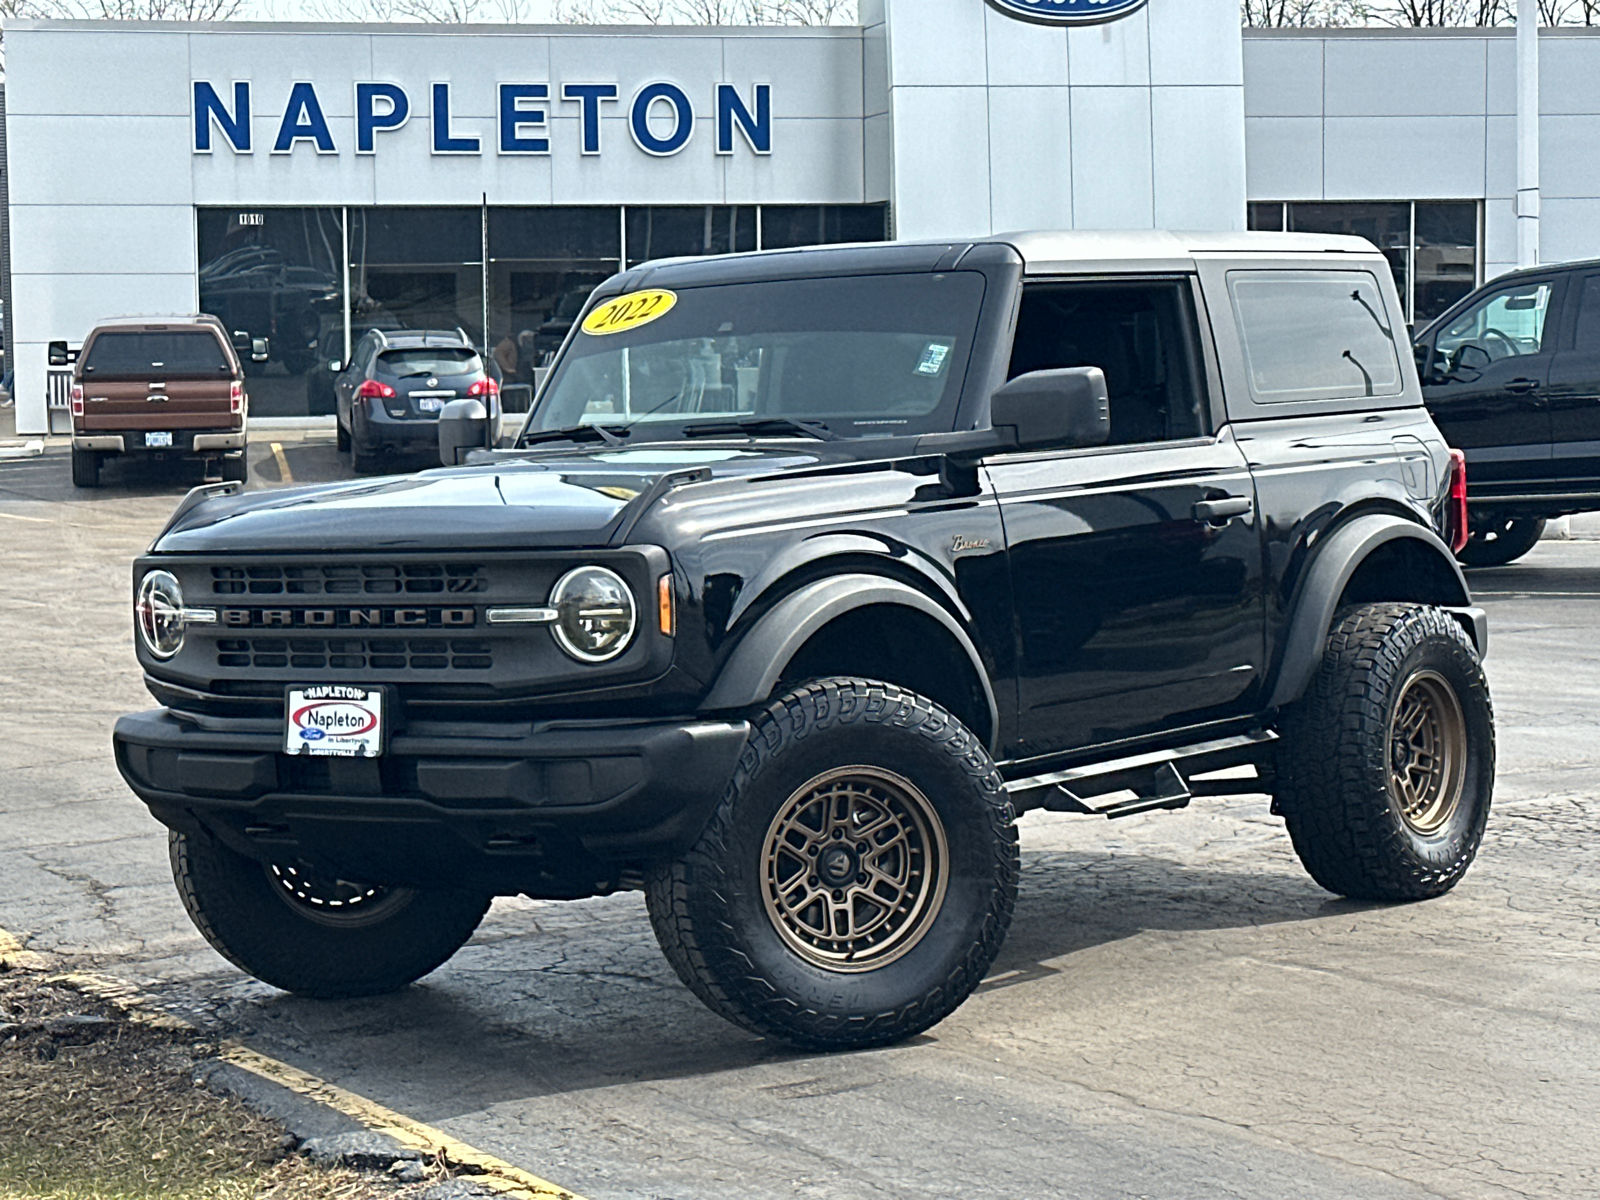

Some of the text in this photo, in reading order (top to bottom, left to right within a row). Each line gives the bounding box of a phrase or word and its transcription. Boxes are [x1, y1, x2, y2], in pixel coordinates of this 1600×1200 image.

[191, 80, 772, 157] NAPLETON
[240, 213, 264, 226] 1010
[593, 294, 663, 329] 2022
[221, 608, 475, 626] BRONCO
[308, 686, 361, 699] NAPLETON
[308, 711, 364, 730] Napleton
[303, 730, 322, 740] Ford
